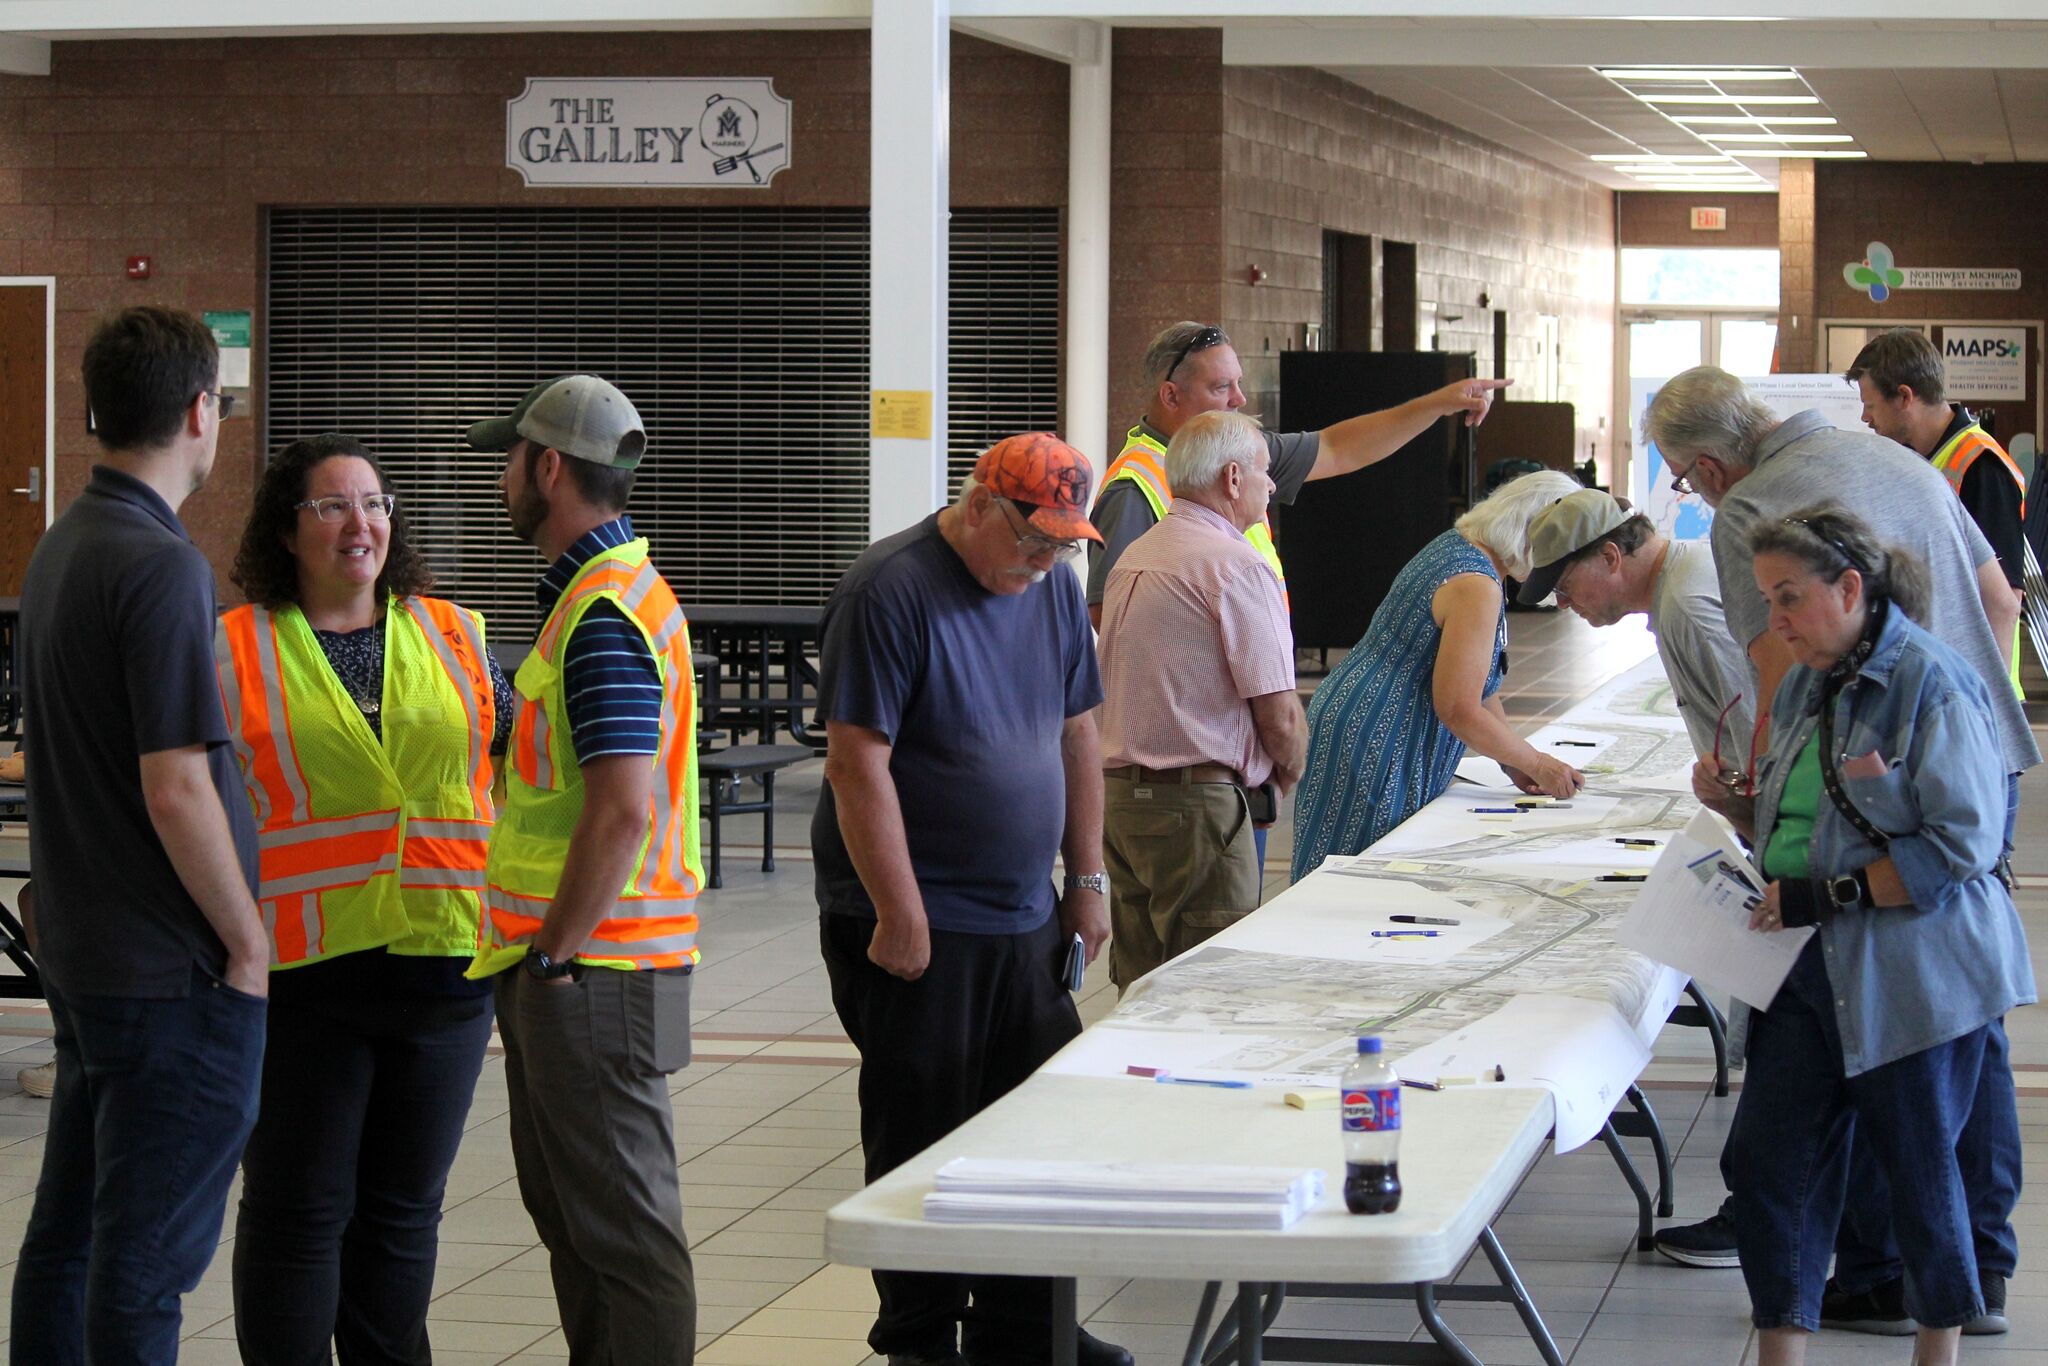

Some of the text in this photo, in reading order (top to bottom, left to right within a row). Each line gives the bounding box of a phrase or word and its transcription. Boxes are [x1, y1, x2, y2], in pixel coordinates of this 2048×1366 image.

[551, 98, 614, 123] THE
[518, 126, 693, 163] GALLEY
[1910, 271, 2017, 280] NORTHWEST MICHIGAN
[1910, 280, 1944, 288] Health
[1952, 280, 1996, 288] Services
[1946, 339, 2008, 357] MAPS
